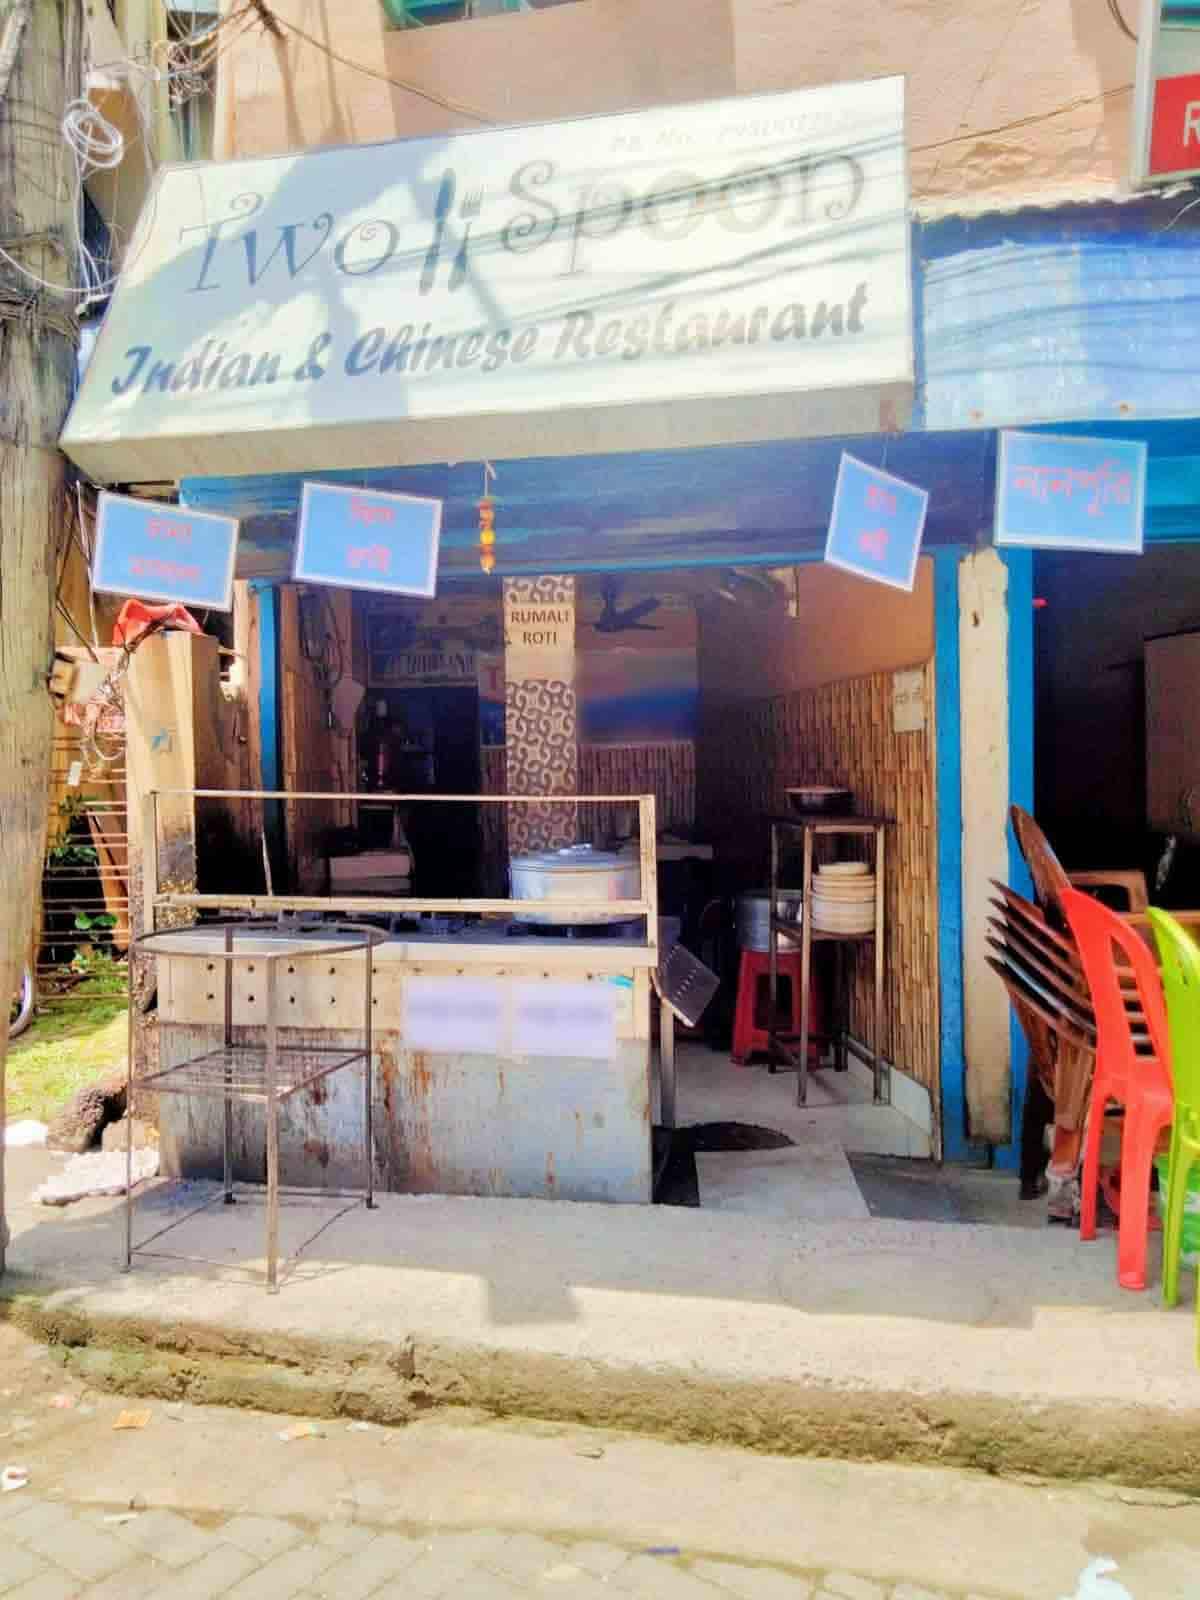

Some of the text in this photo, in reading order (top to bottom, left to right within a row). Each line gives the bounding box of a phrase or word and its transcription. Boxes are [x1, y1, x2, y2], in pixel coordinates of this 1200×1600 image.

[500, 154, 865, 279] Spoon
[111, 281, 869, 396] Indian & Chinese Restaurant
[510, 609, 569, 624] RUMALI
[522, 631, 558, 646] ROTI
